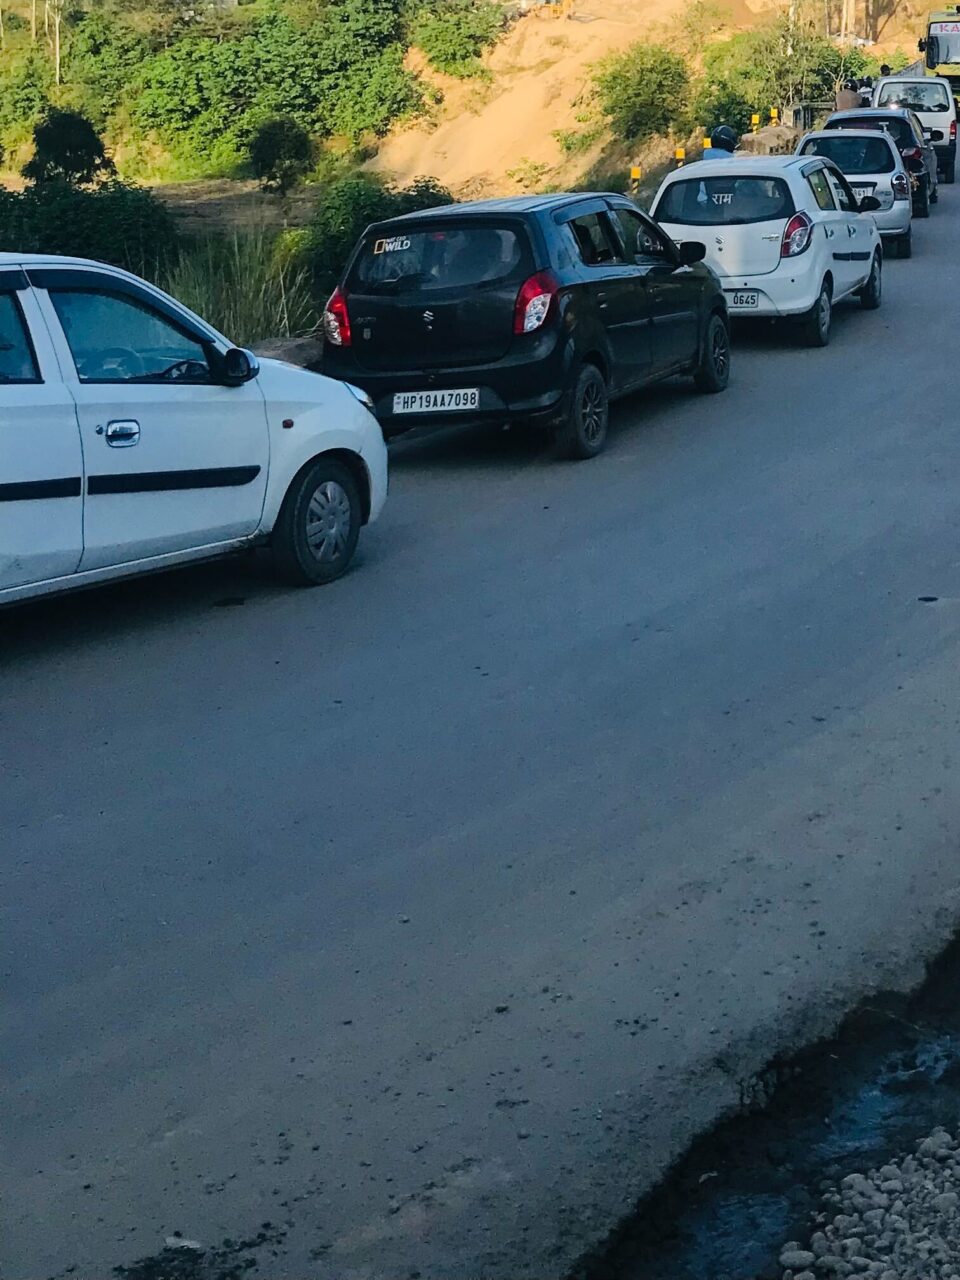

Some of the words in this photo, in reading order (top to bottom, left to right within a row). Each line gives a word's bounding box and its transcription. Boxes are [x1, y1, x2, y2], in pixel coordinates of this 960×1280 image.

[711, 192, 733, 205] राम
[385, 240, 411, 252] WILD
[733, 294, 756, 305] 0645
[402, 392, 477, 410] HP19AA7098
